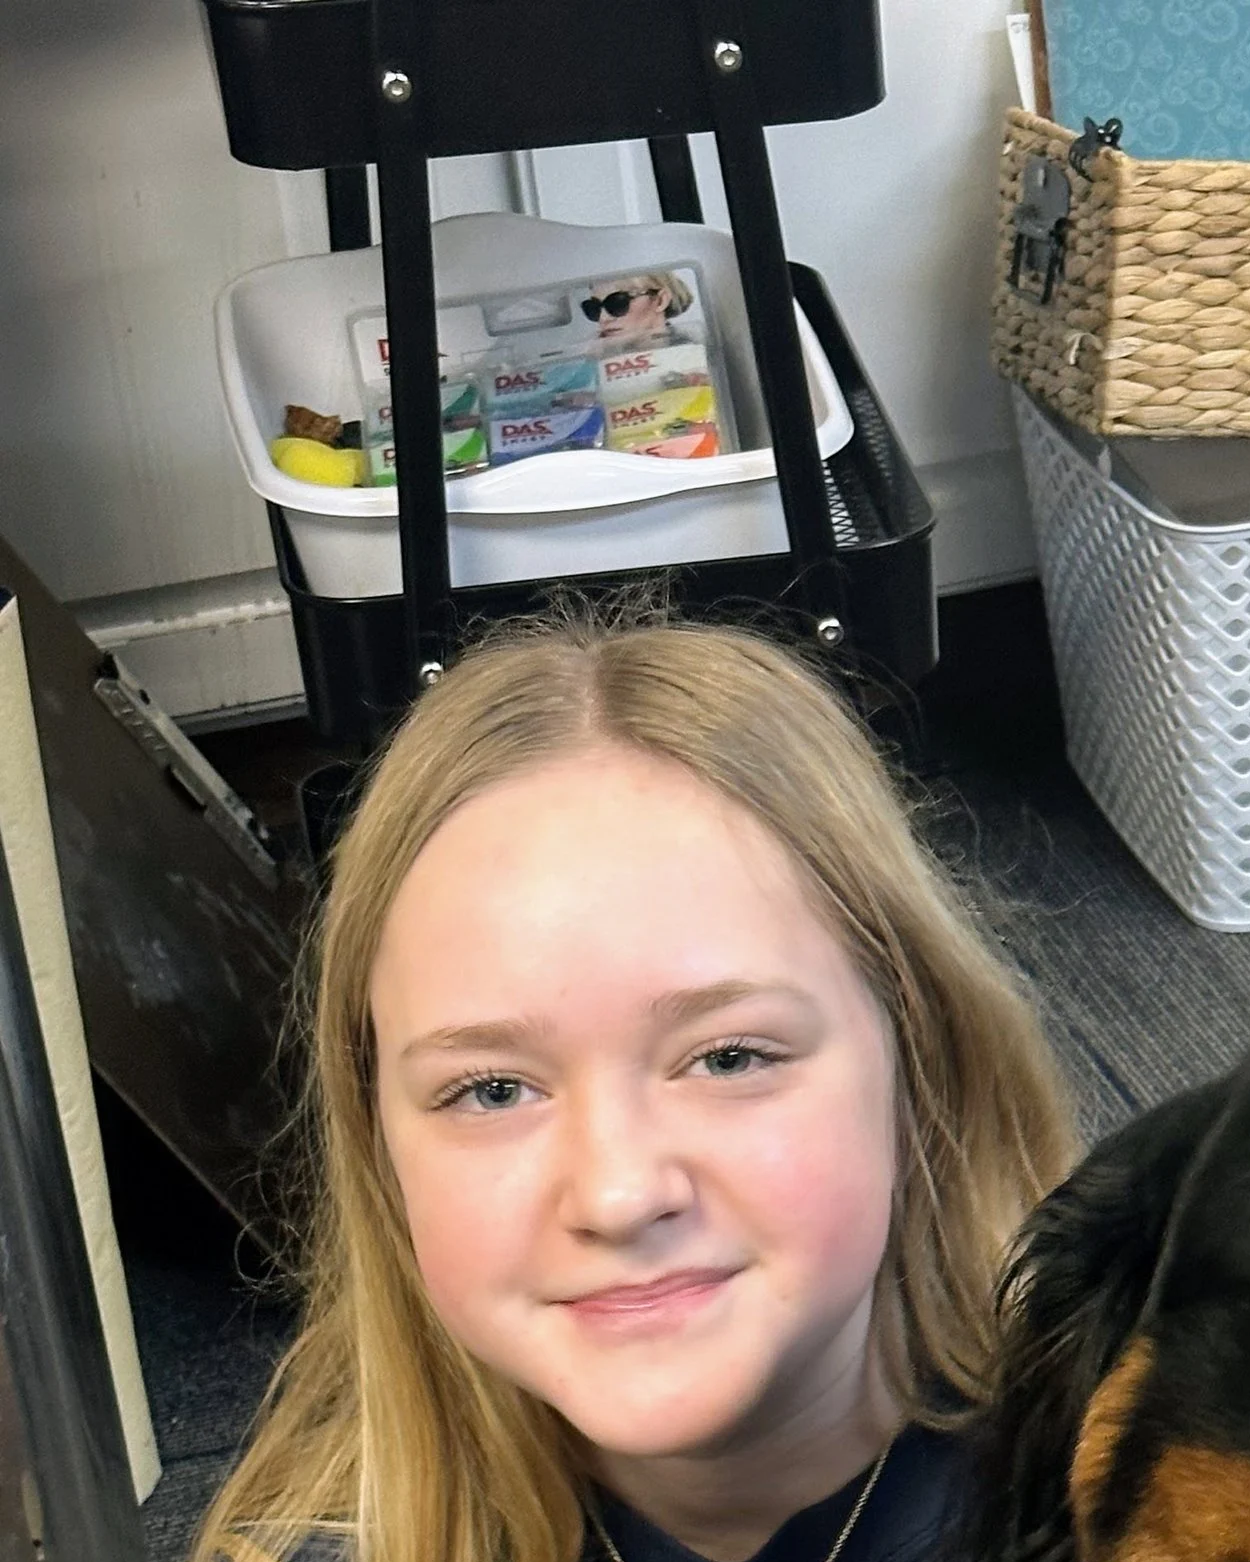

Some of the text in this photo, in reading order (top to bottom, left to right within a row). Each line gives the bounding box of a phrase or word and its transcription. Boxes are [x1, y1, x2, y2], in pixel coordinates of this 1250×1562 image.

[605, 352, 654, 376] DAS
[495, 371, 545, 389] DAS
[610, 400, 660, 423] DAS
[502, 419, 552, 437] DAS
